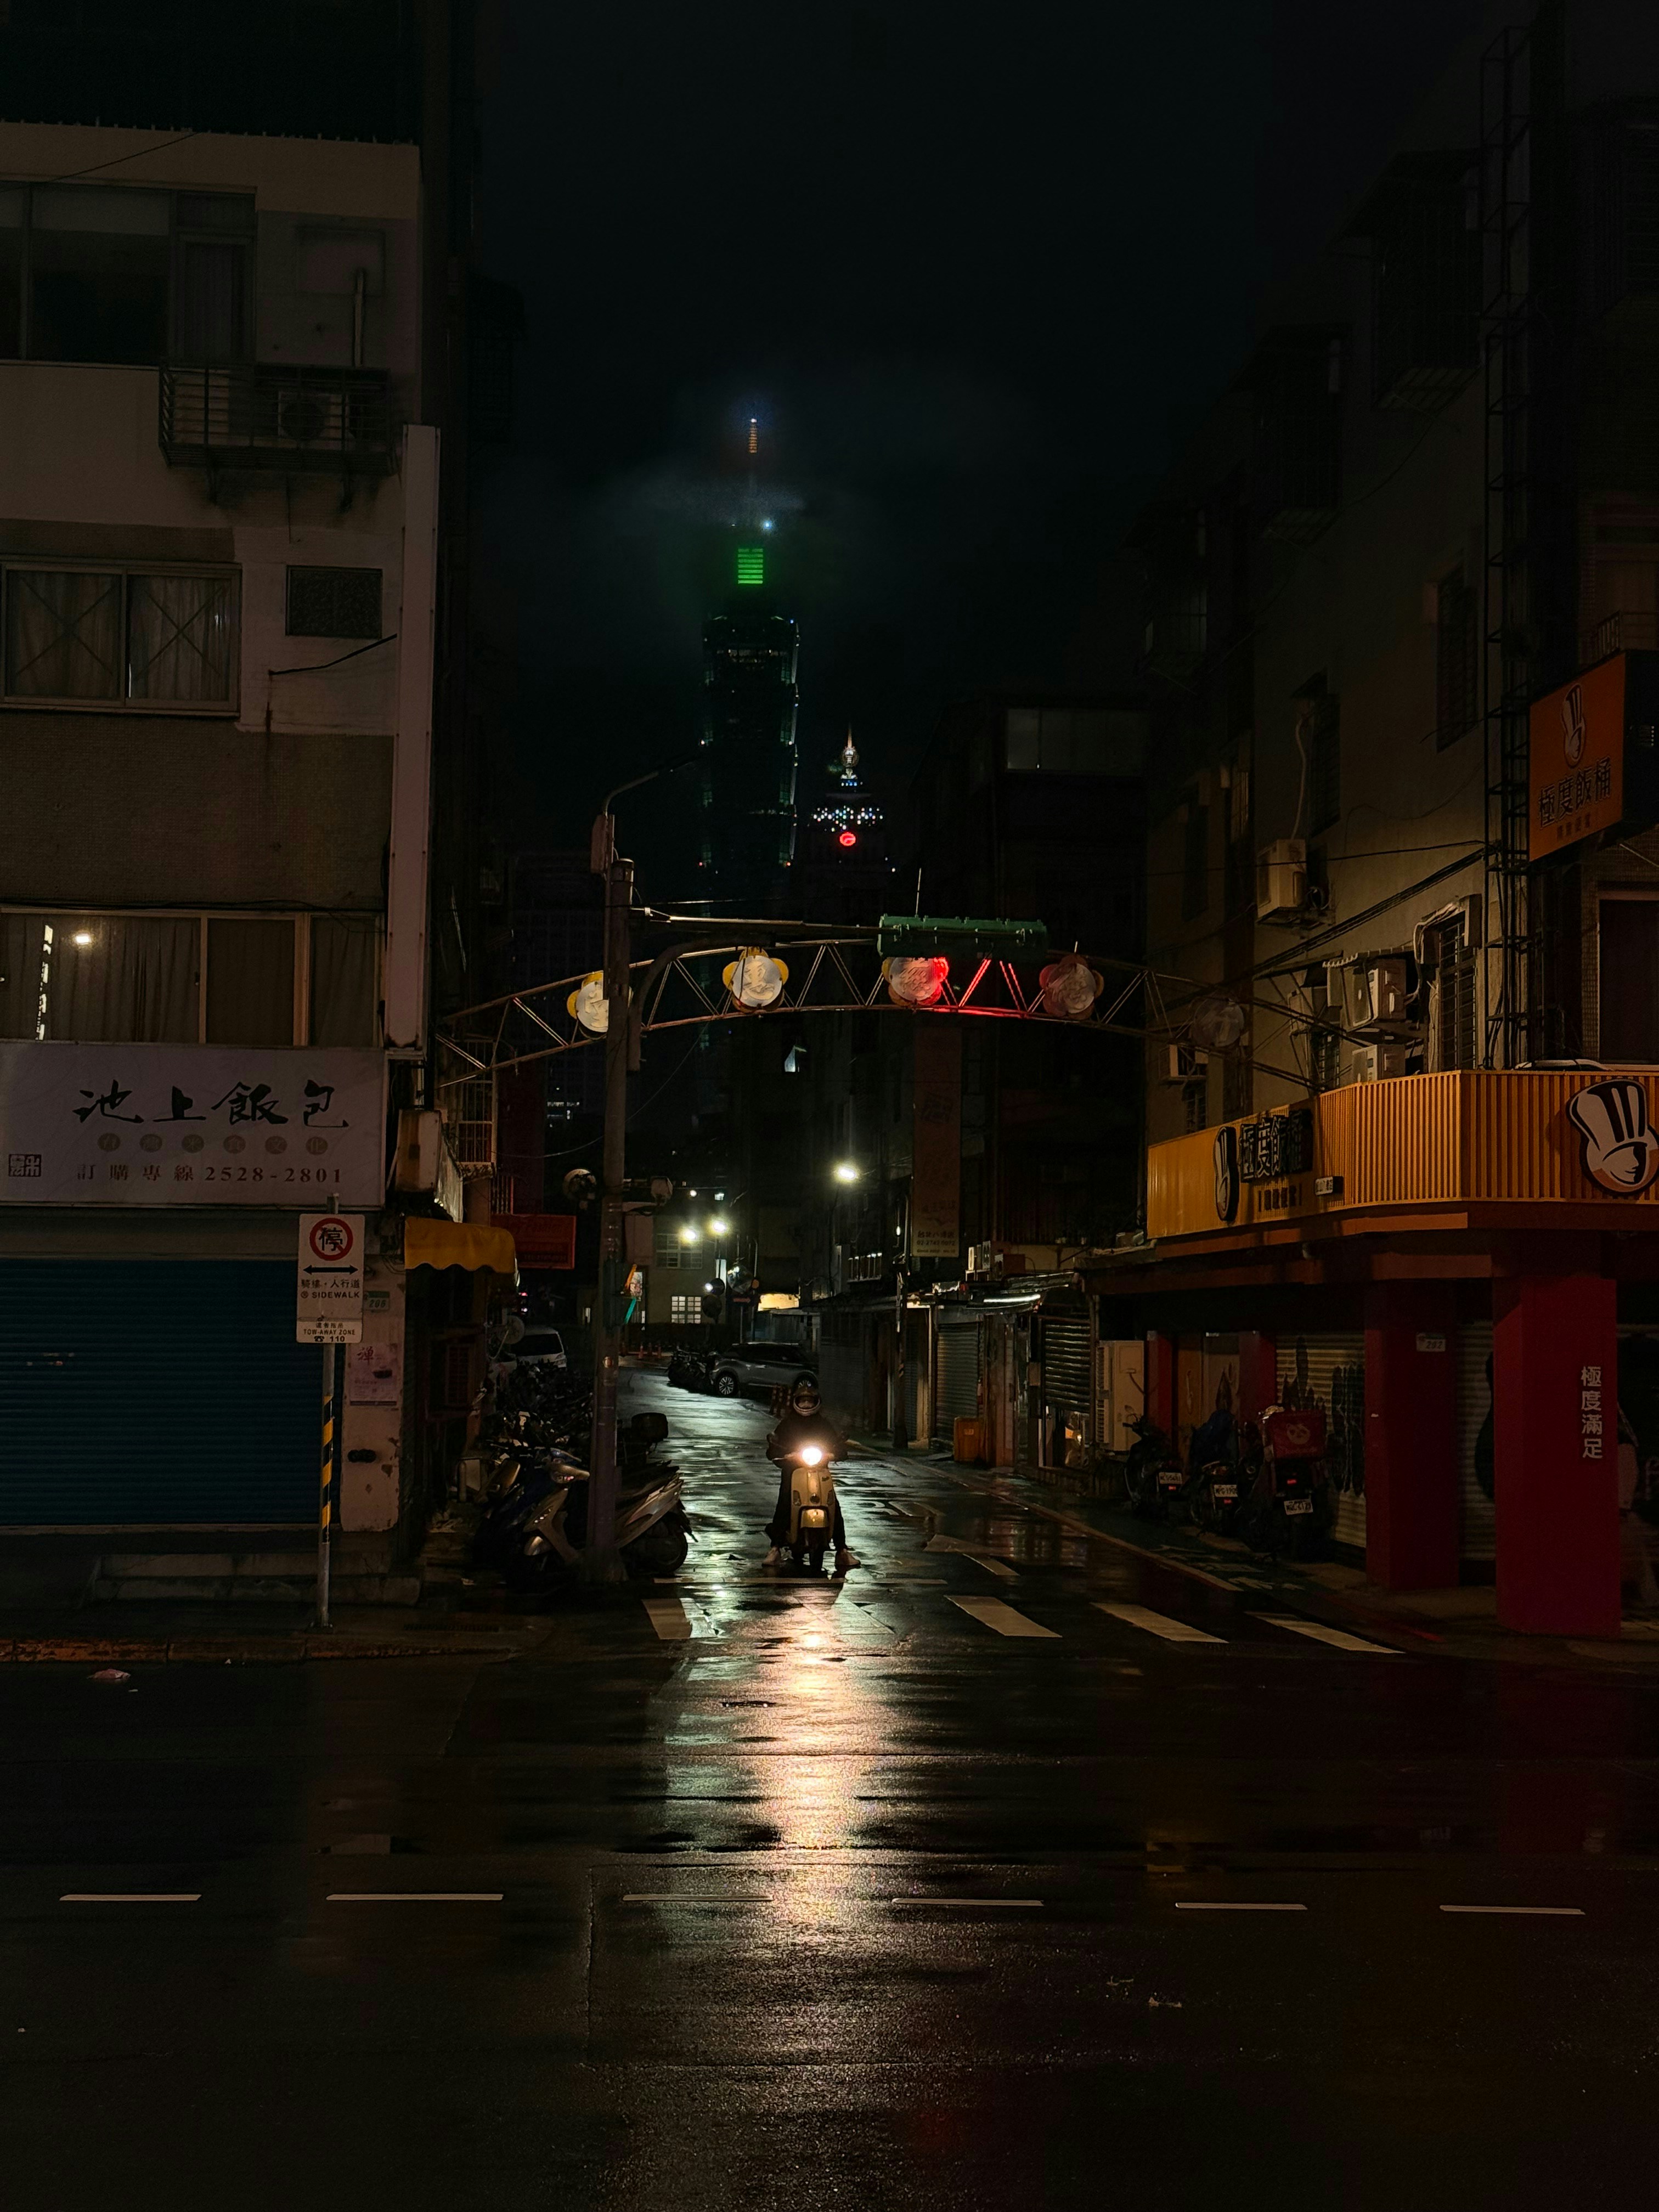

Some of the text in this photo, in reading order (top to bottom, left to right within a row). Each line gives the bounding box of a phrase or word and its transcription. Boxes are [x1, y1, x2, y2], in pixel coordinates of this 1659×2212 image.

[73, 1079, 349, 1127] 池上飯包
[77, 1164, 341, 1183] 訂購專線 2528-2801
[318, 1227, 343, 1251] 停
[1580, 1365, 1603, 1460] 極度滿足
